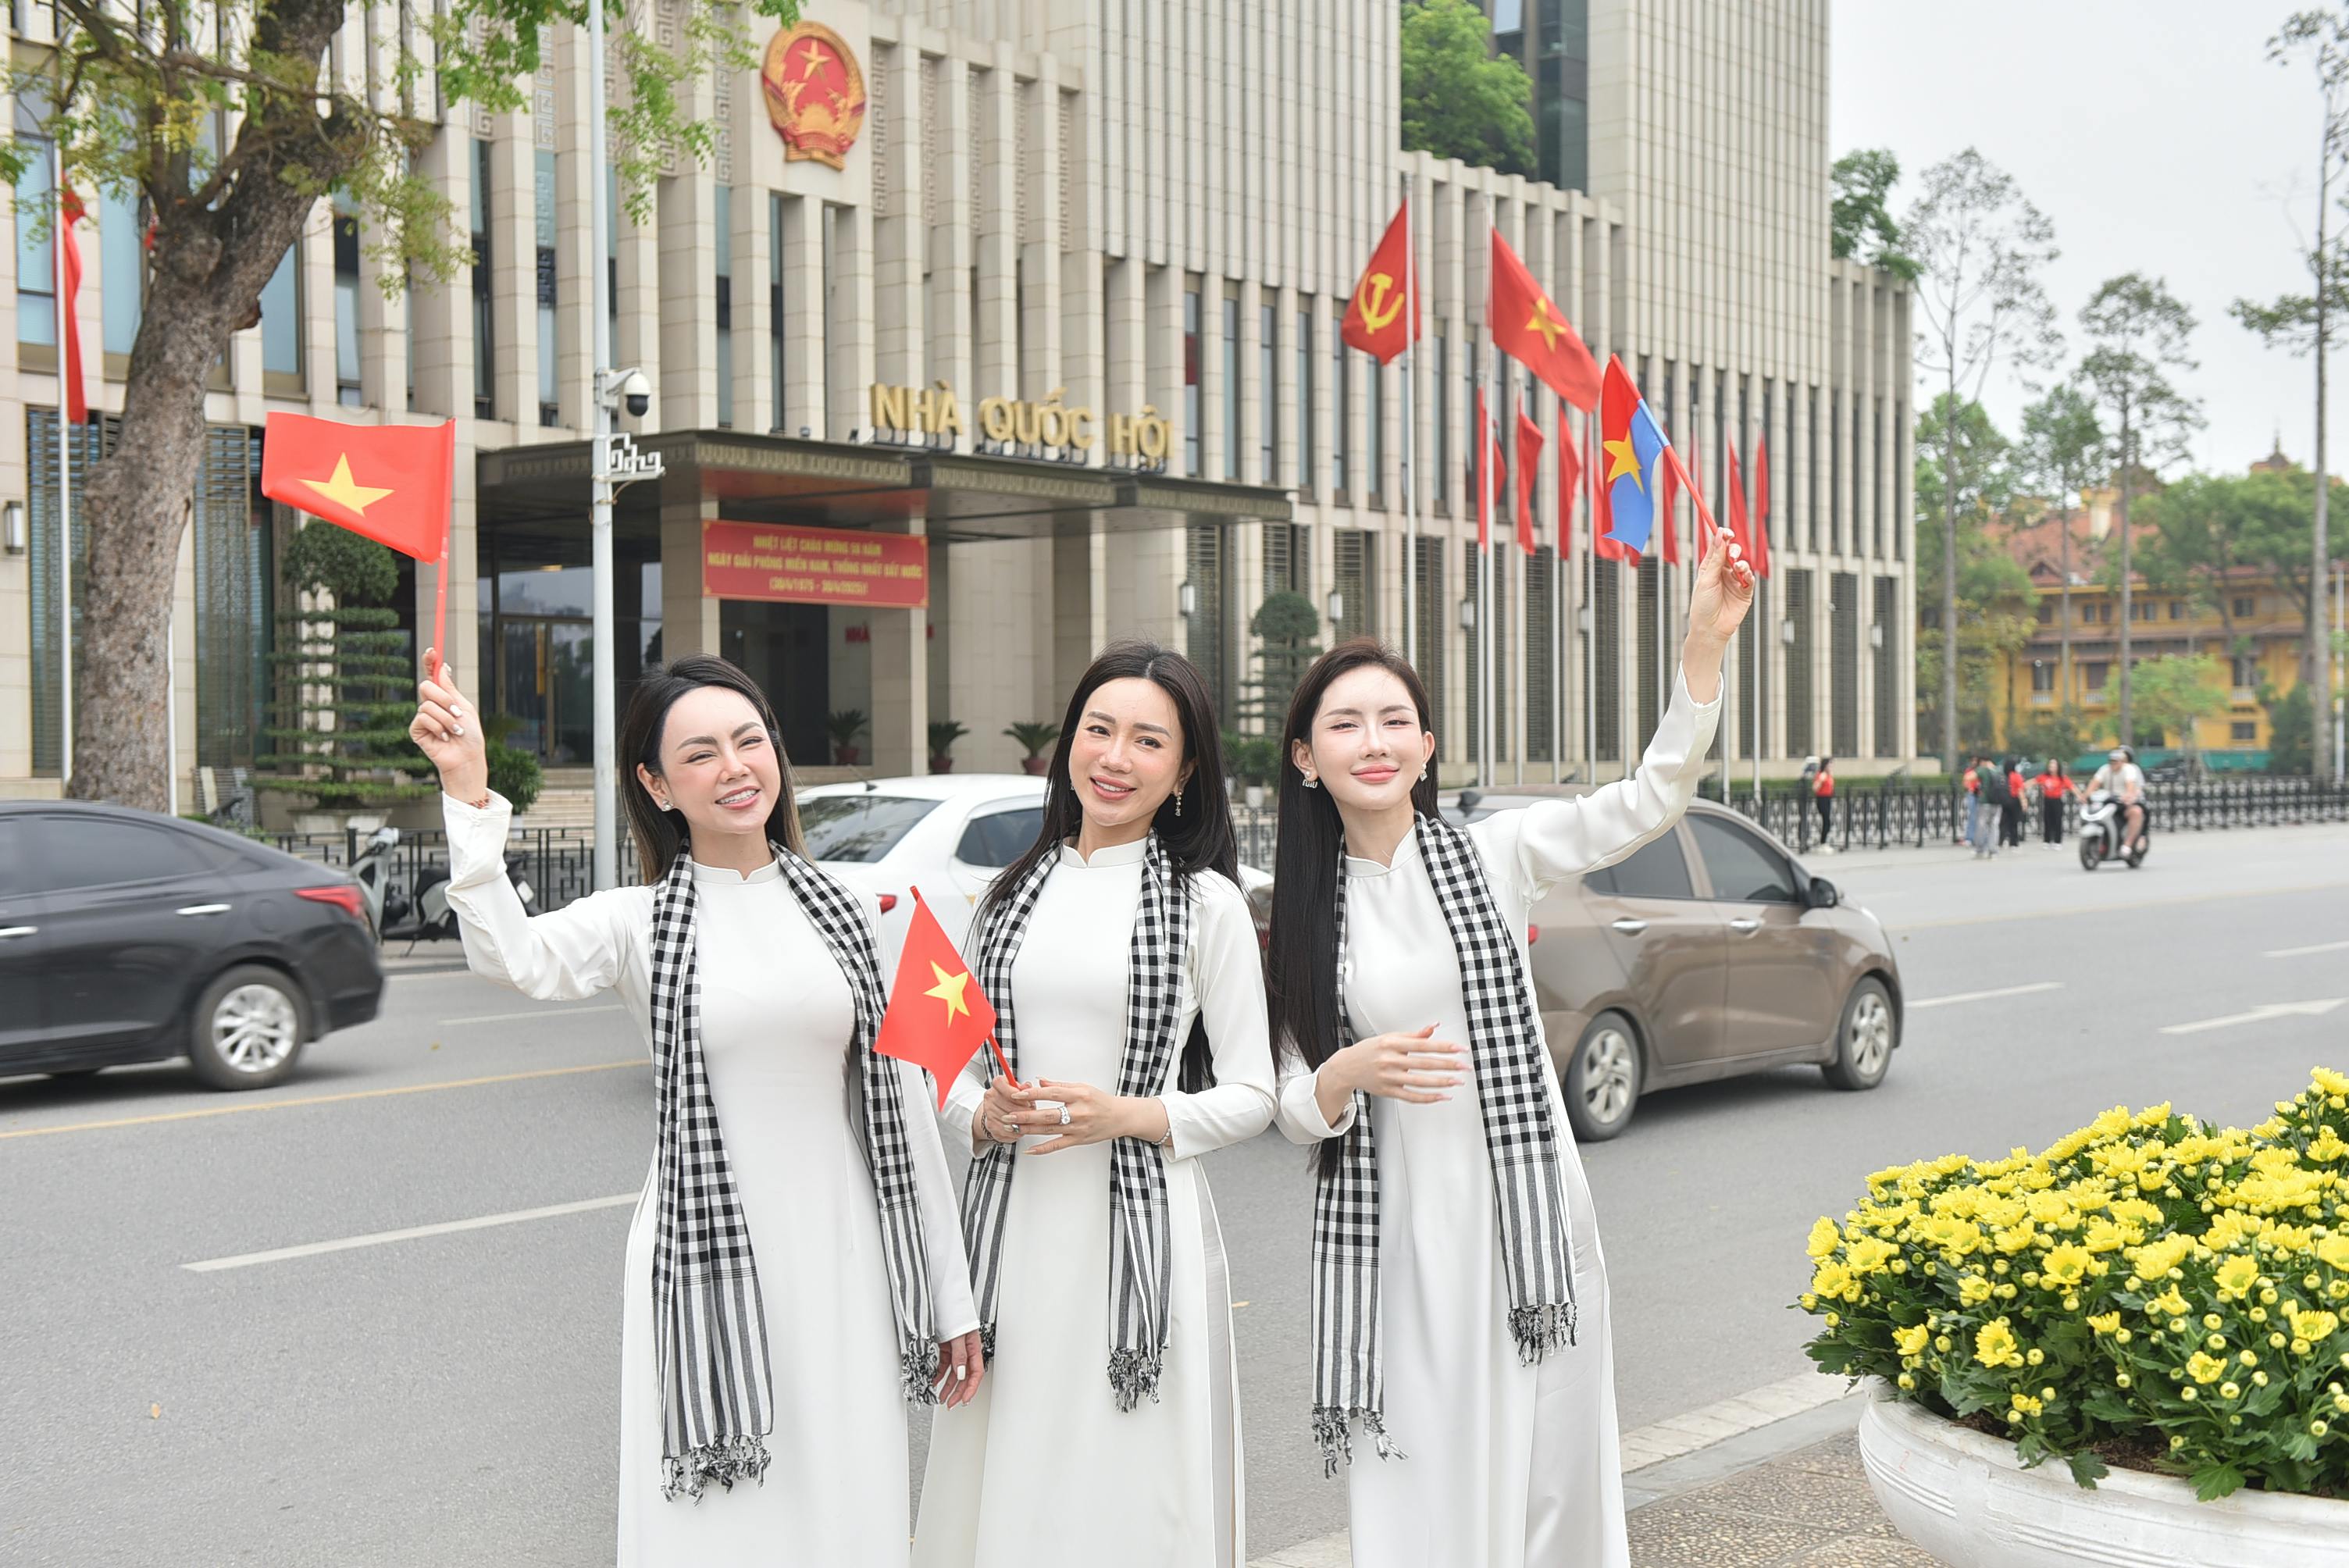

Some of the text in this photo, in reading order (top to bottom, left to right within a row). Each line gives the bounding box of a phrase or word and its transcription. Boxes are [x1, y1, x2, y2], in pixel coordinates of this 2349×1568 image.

[871, 379, 1171, 468] NHÀ QUỐC HỘI
